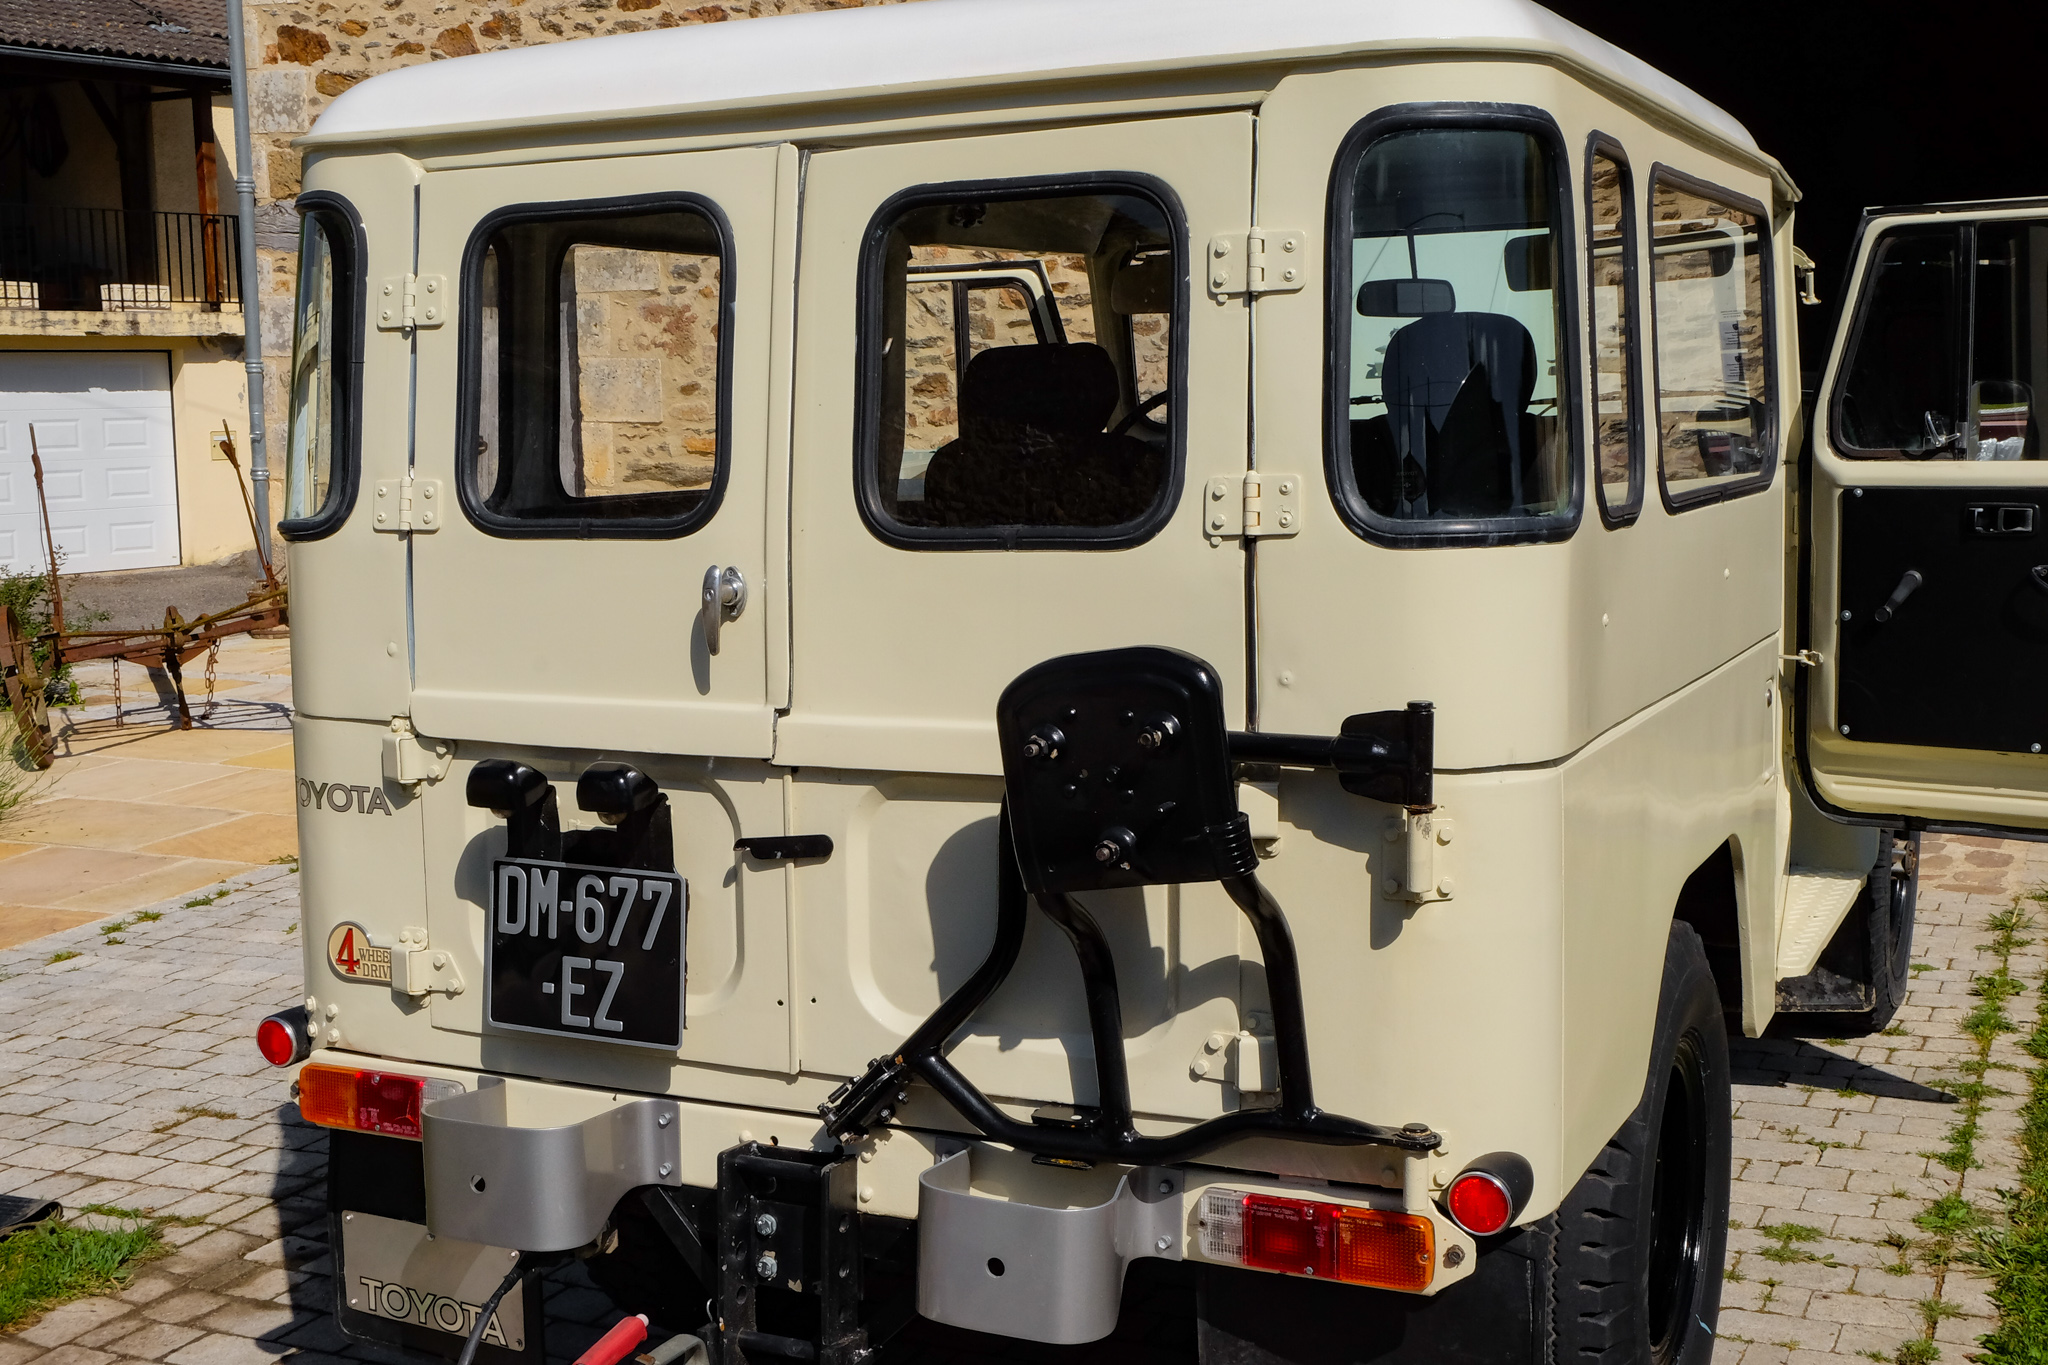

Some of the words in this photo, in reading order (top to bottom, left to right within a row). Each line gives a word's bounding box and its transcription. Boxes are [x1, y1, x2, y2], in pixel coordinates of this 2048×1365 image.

[296, 776, 393, 816] OYOTA
[498, 865, 673, 951] DM-677
[336, 928, 360, 974] 4
[360, 1276, 508, 1347] TOYOTA
